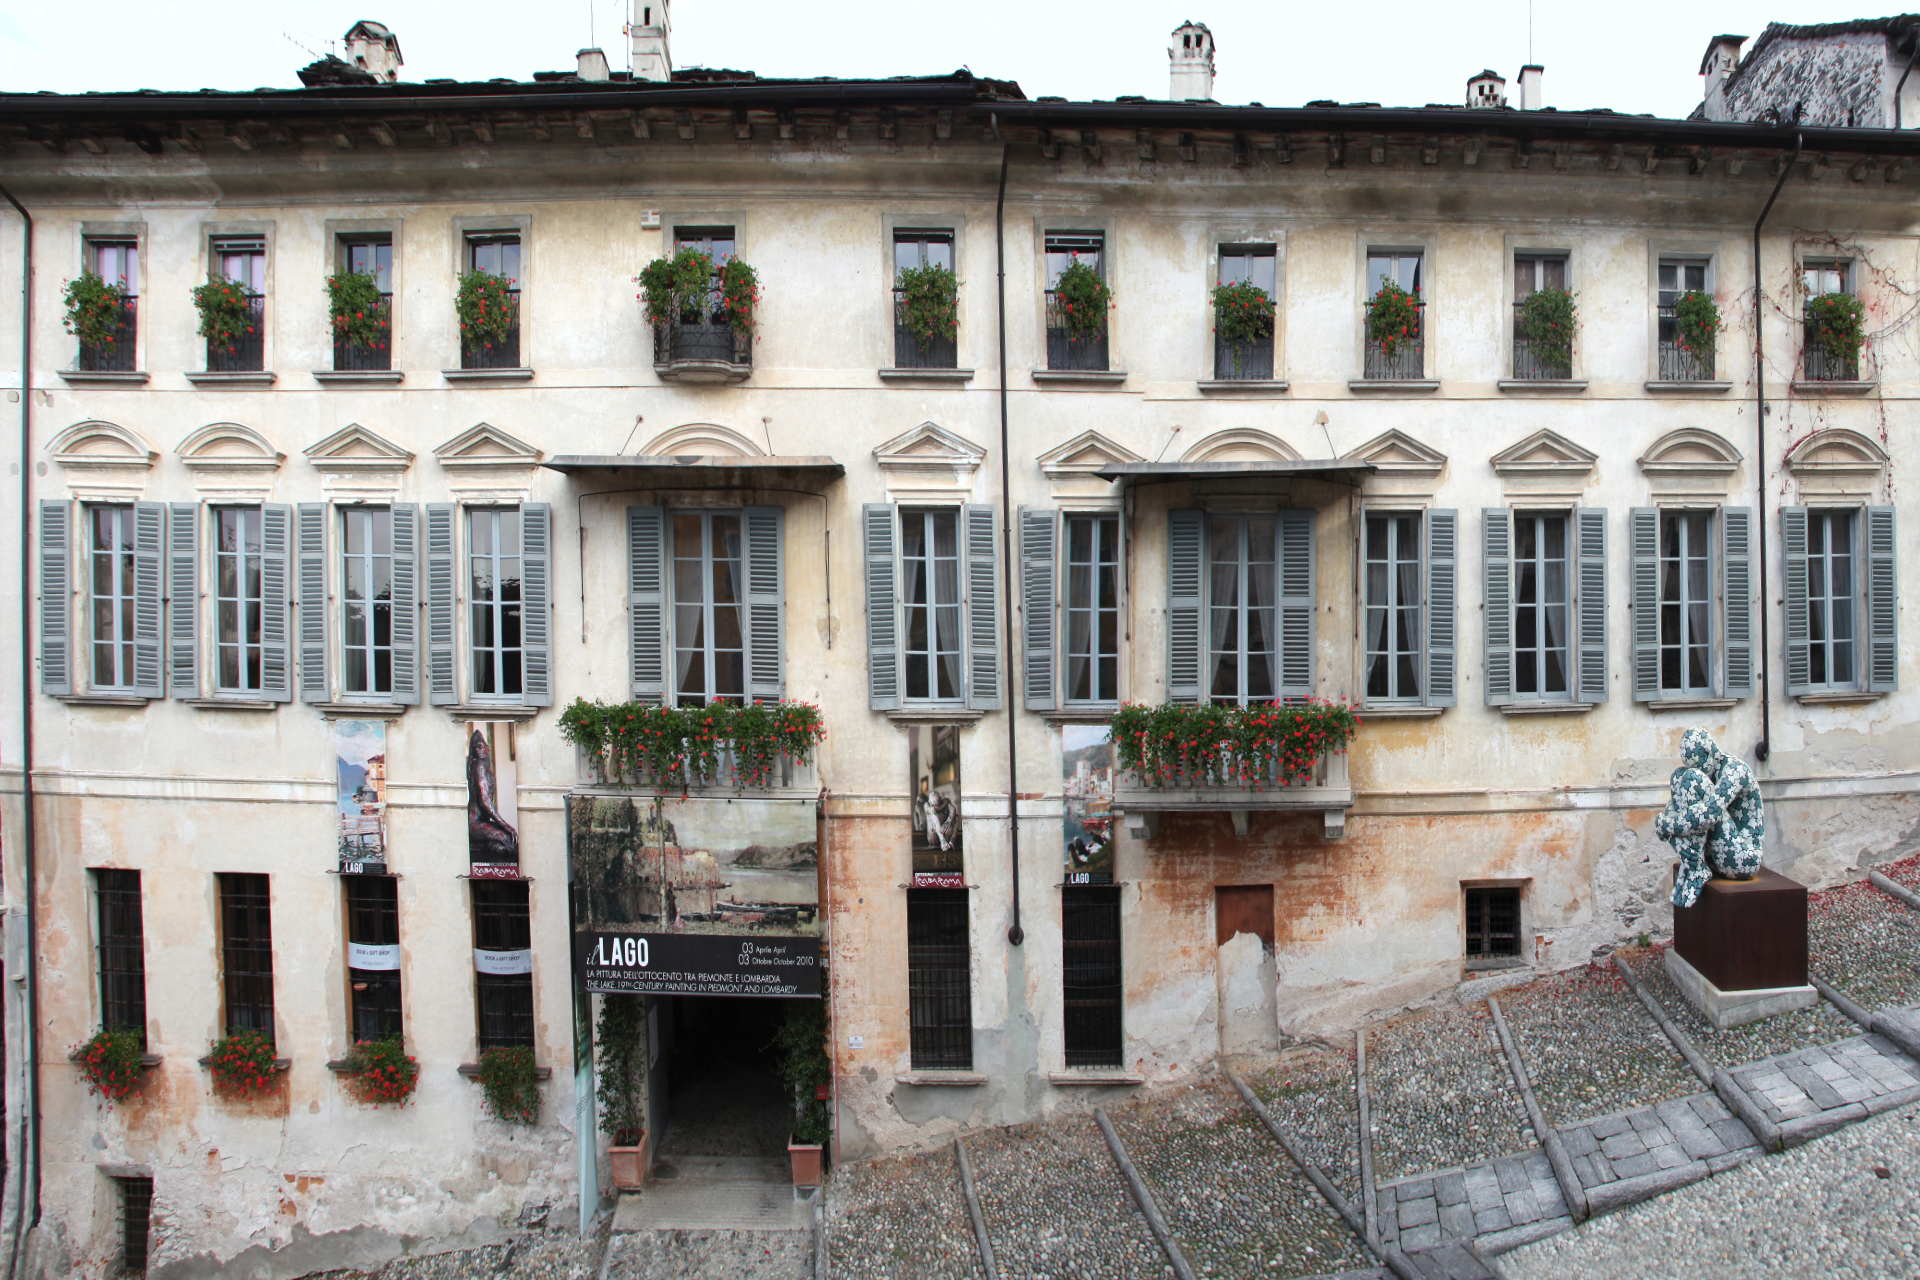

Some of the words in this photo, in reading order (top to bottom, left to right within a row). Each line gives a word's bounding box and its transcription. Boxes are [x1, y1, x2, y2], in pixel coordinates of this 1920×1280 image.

[345, 862, 363, 873] LAGO
[1070, 872, 1089, 884] LAGO
[586, 944, 600, 965] il
[599, 937, 649, 967] LAGO
[741, 942, 753, 954] 03
[755, 946, 771, 955] Aprile
[773, 946, 787, 955] April
[738, 953, 750, 965] 03
[751, 957, 772, 965] Ottobre
[773, 957, 795, 965] October
[796, 956, 814, 966] 2010
[586, 969, 595, 978] LA
[596, 970, 622, 979] PITTURA
[623, 971, 683, 981] DELL'OTTOCENTO
[684, 972, 697, 981] TRA
[698, 973, 733, 982] PIEMONTE
[735, 974, 739, 982] E
[741, 974, 781, 983] LOMBARDIA
[586, 980, 598, 989] THE
[665, 982, 697, 991] PAINTING
[698, 983, 706, 992] IN
[708, 984, 743, 992] PIEDMONT
[744, 985, 760, 993] AND
[761, 985, 798, 994] LOMBARDY
